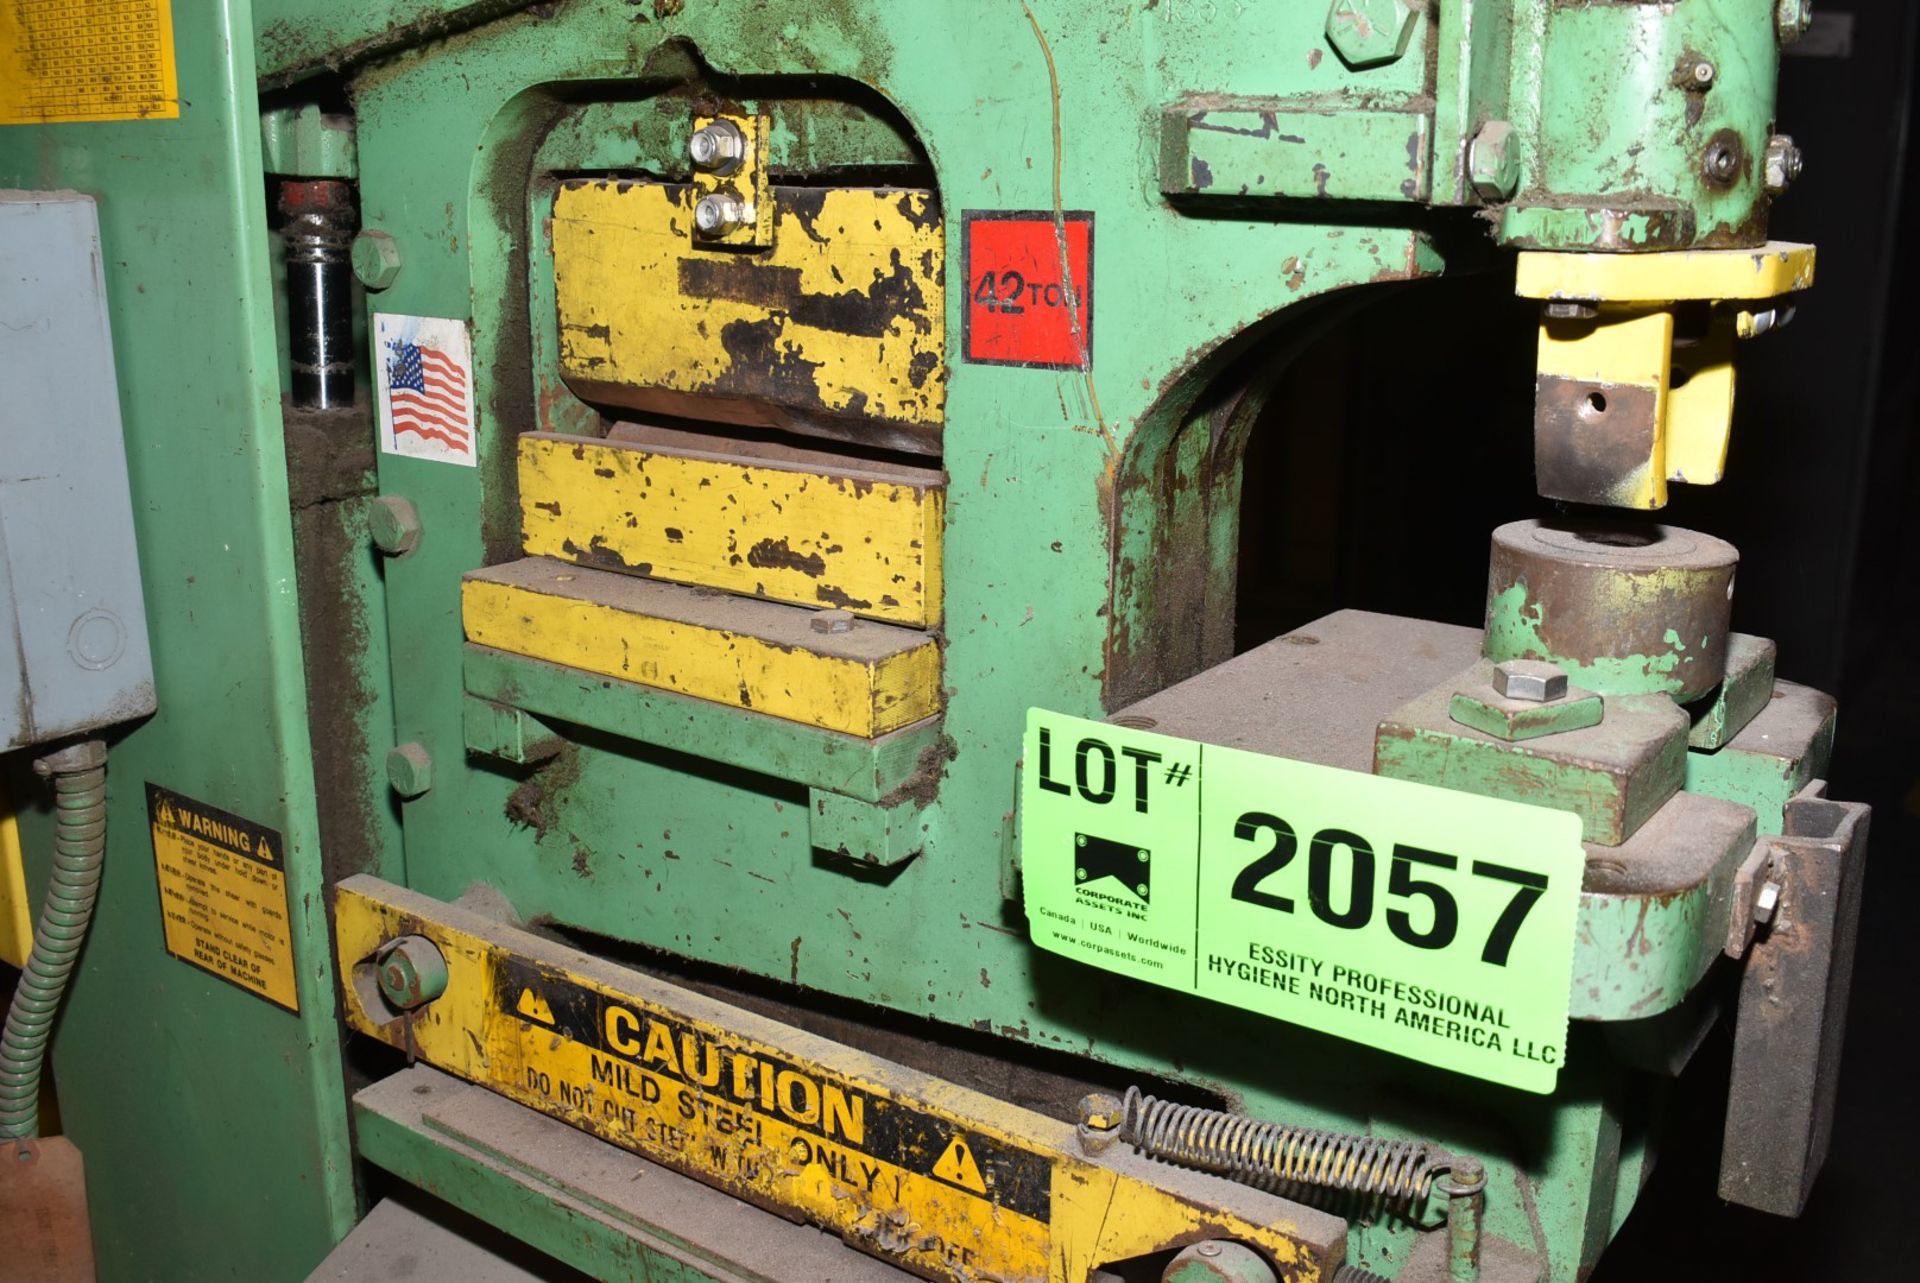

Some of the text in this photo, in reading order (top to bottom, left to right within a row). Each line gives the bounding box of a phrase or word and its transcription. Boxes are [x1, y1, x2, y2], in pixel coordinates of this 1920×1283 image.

[974, 271, 1025, 314] 42
[178, 807, 251, 852] WARNING
[1075, 887, 1148, 912] CORPORATE
[1075, 897, 1148, 922] ASSETS INC
[1231, 811, 1549, 967] 2057
[1039, 906, 1187, 955] Canada USA Worldwide
[1052, 931, 1164, 969] www.corpassets.com
[193, 947, 266, 990] REAR OF MACHINE
[195, 936, 261, 975] STAND CLEAR OF
[1249, 942, 1511, 1029] ESSITY PROFESSIONAL
[1208, 954, 1557, 1065] HYGIENE NORTH AMERICA LLC
[527, 1066, 551, 1096] DO
[560, 1080, 593, 1114] NOT
[604, 1005, 865, 1145] CAUTION
[591, 1053, 661, 1105] MILD
[790, 1136, 881, 1193] ONLY
